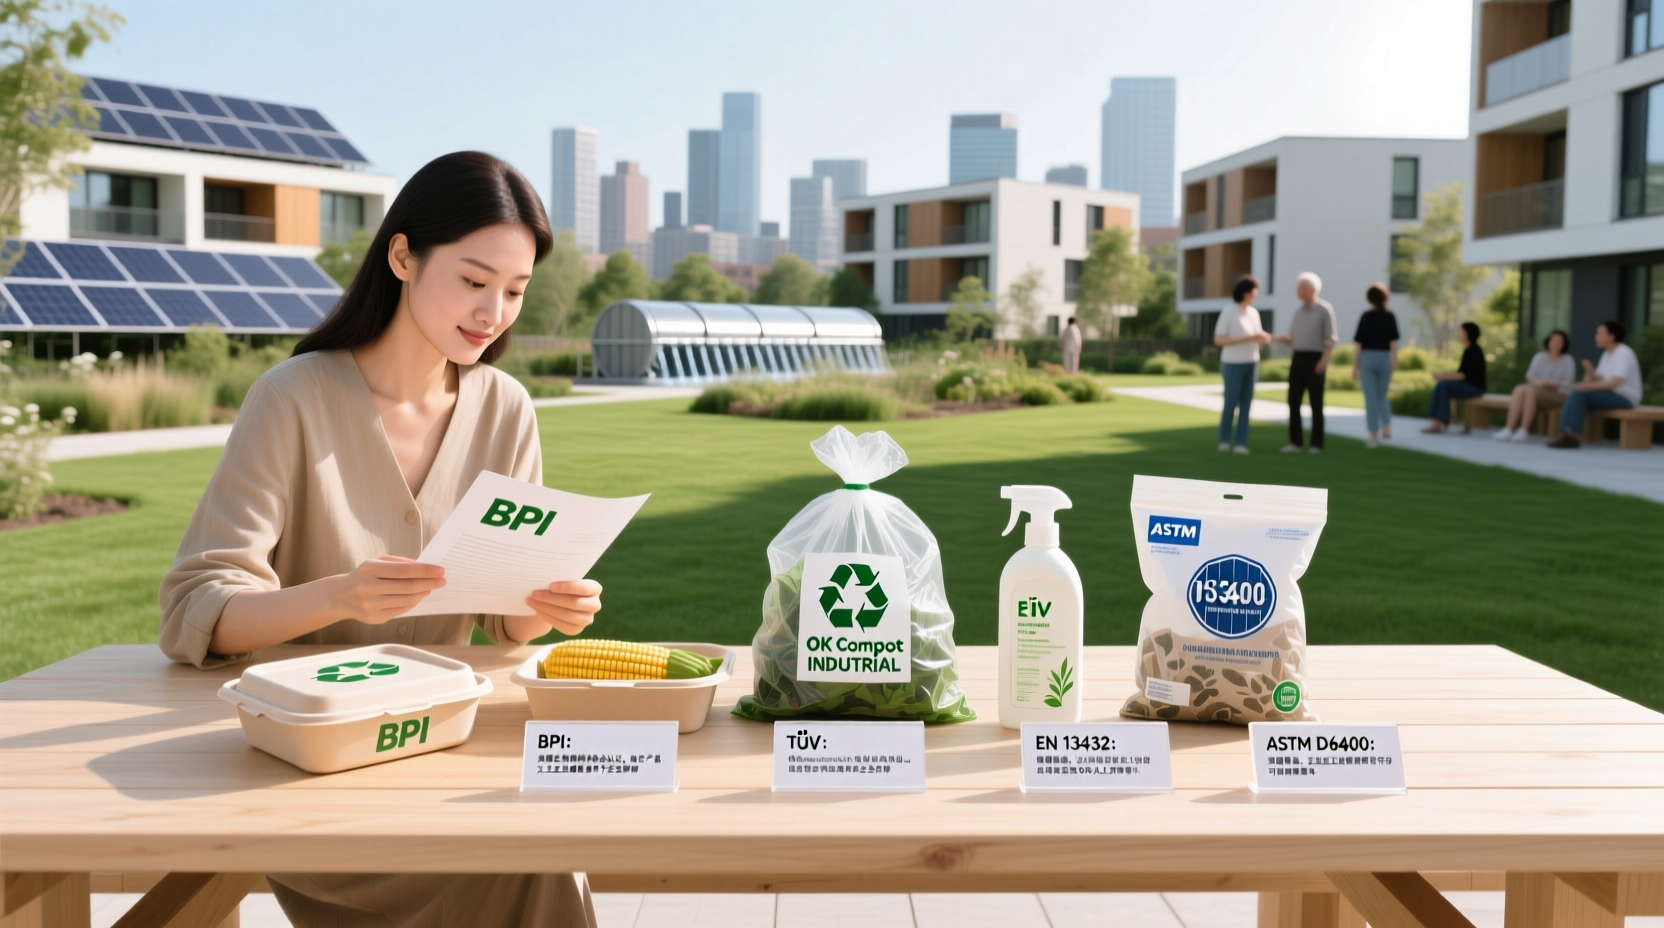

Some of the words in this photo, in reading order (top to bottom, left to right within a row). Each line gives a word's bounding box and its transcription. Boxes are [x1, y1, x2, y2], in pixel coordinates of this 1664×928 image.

[480, 497, 558, 536] BPI
[1150, 522, 1197, 539] ASTM
[806, 635, 833, 652] OK
[836, 636, 904, 657] Compot
[808, 656, 901, 673] INDUTRIAL
[375, 716, 430, 753] BPI
[538, 734, 571, 749] BPI:
[786, 729, 827, 750] TÜV:
[1266, 736, 1311, 751] ASTM
[1316, 735, 1375, 751] D6400:
[1036, 735, 1058, 750] EN
[1063, 735, 1116, 752] 13432:
